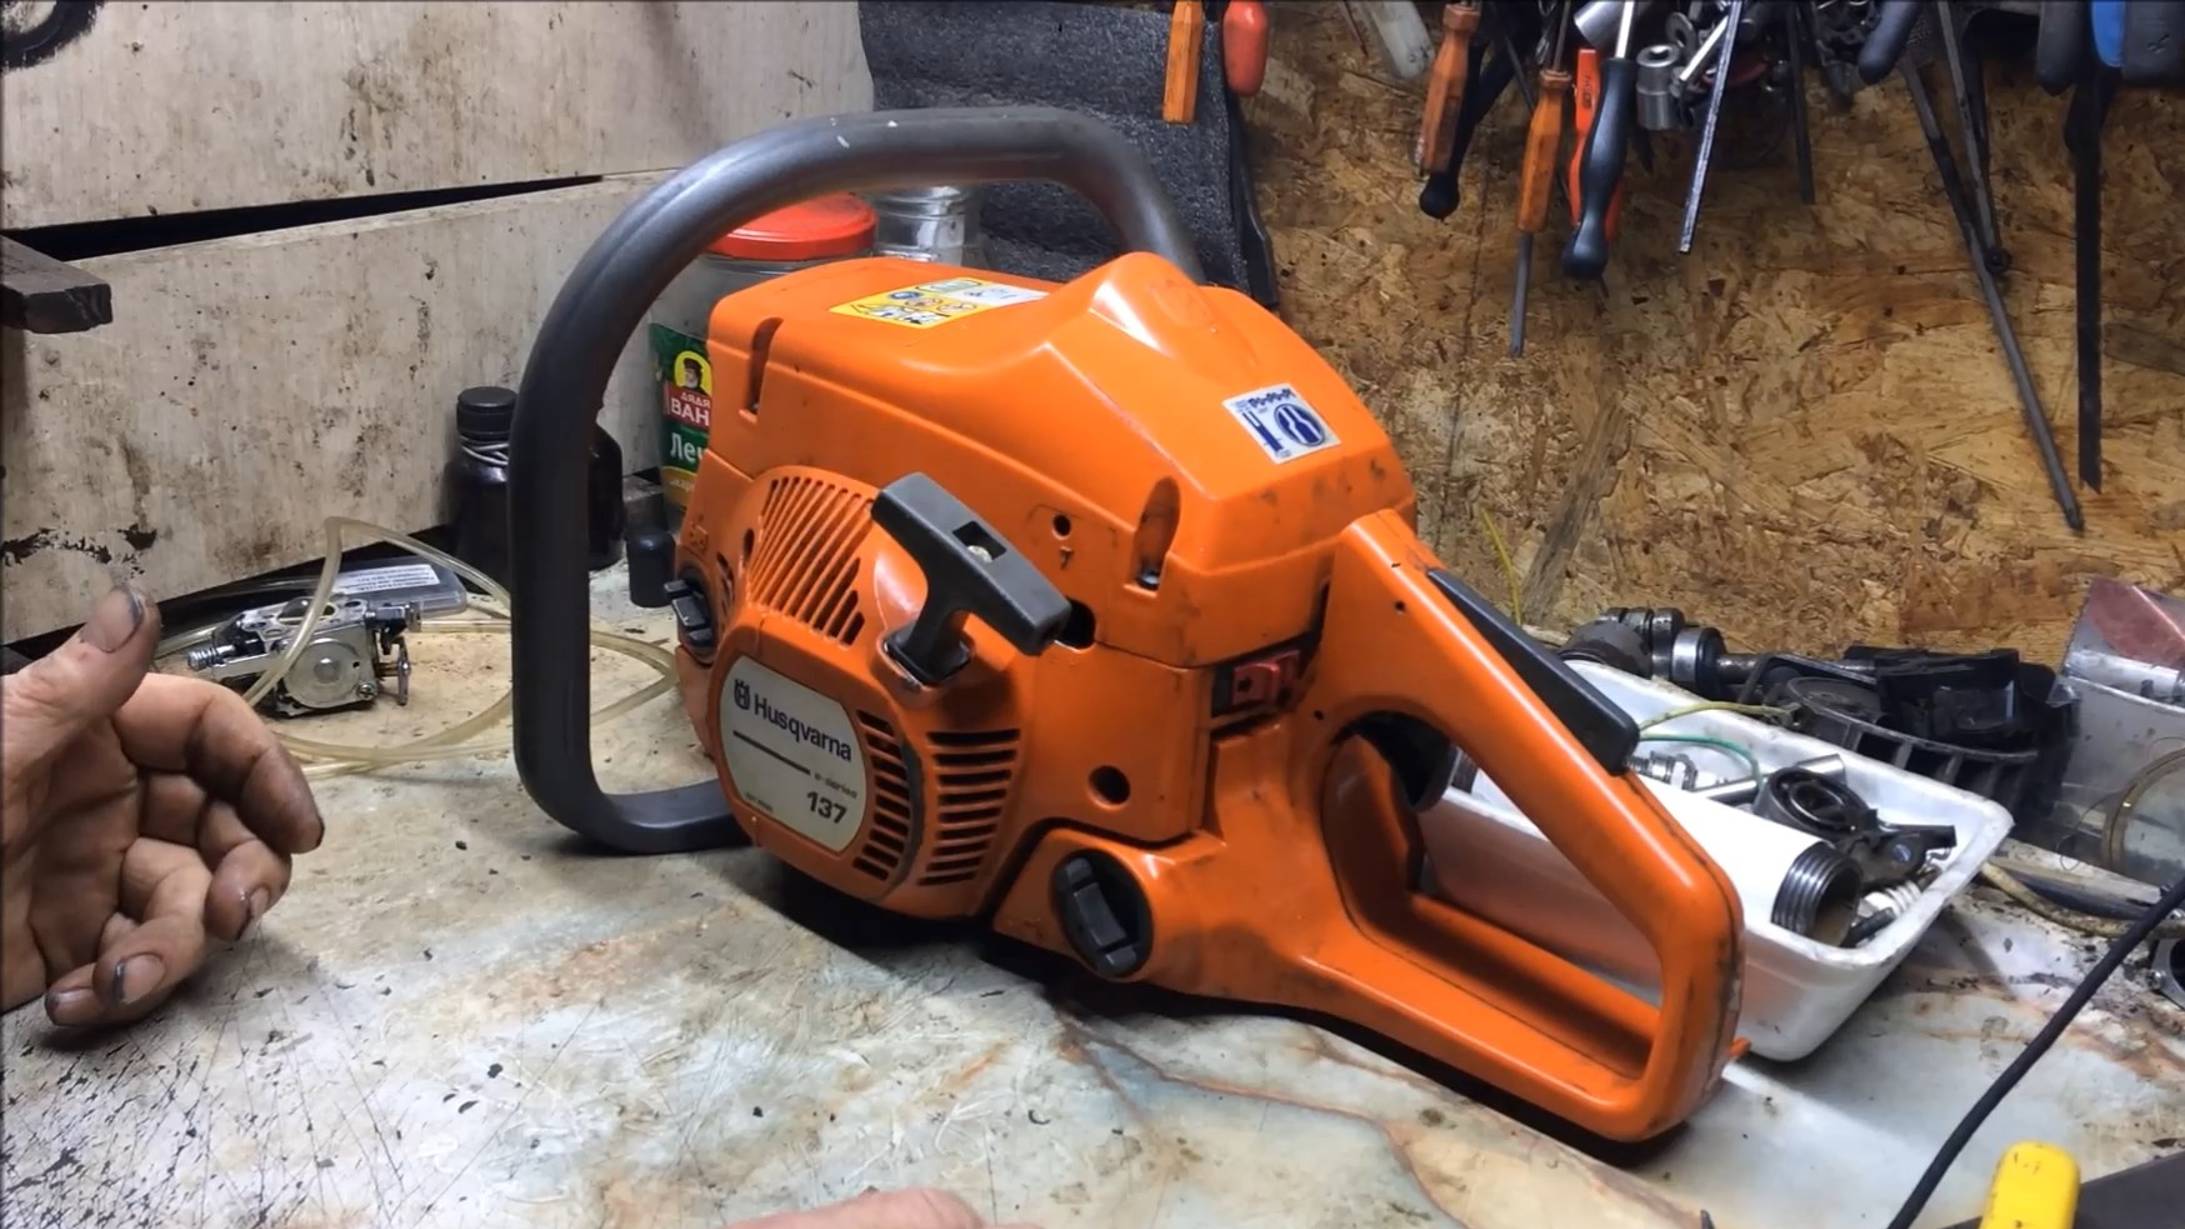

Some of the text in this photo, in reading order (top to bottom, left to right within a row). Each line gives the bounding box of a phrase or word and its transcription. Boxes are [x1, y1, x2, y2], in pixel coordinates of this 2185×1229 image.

[670, 397, 710, 427] ВАН
[754, 693, 852, 762] Husqvarna
[806, 791, 848, 824] 137
